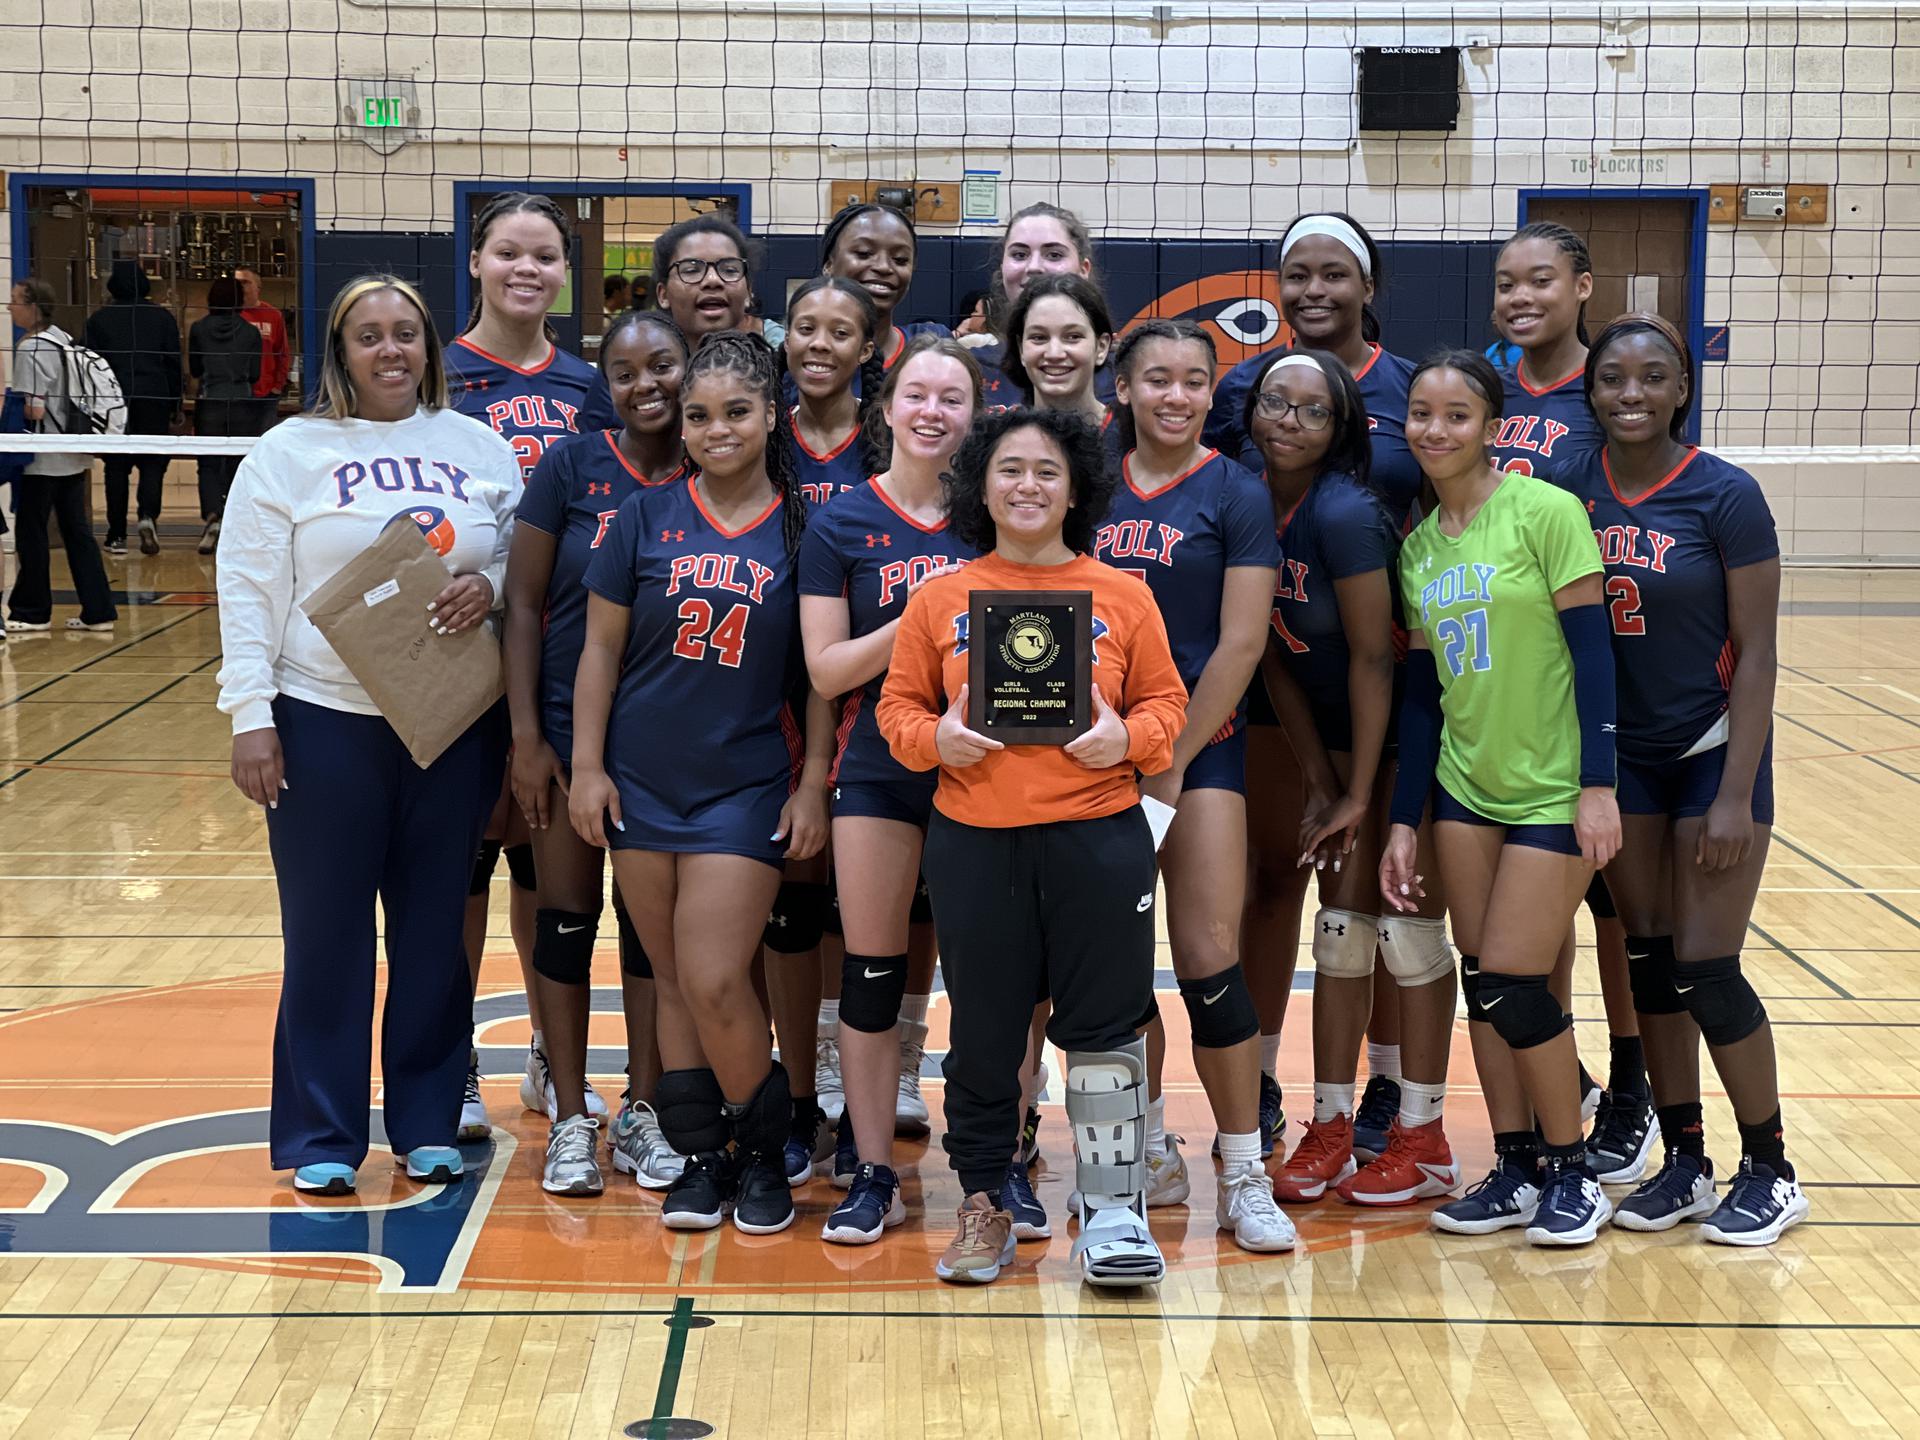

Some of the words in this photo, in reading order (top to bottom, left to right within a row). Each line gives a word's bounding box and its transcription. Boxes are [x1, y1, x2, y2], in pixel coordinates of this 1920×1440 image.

[365, 97, 401, 127] EXIT
[1570, 158, 1588, 173] TO
[1599, 158, 1665, 173] LOCKERS
[485, 395, 580, 434] POLY
[1494, 415, 1570, 458] OLY
[333, 456, 471, 509] POLY
[1093, 519, 1184, 567] POLY
[665, 553, 775, 605] POLY
[1273, 558, 1309, 603] LY
[1420, 562, 1497, 625] POLY
[1008, 611, 1051, 625] MARYLAND
[1605, 575, 1647, 636] 2
[672, 597, 751, 669] 24
[1435, 607, 1492, 679] 27
[999, 643, 1023, 672] ATHLETIC
[1024, 643, 1061, 674] ASSOCIATION
[993, 699, 1028, 708] REGIONAL
[1029, 699, 1066, 708] CHAMPION
